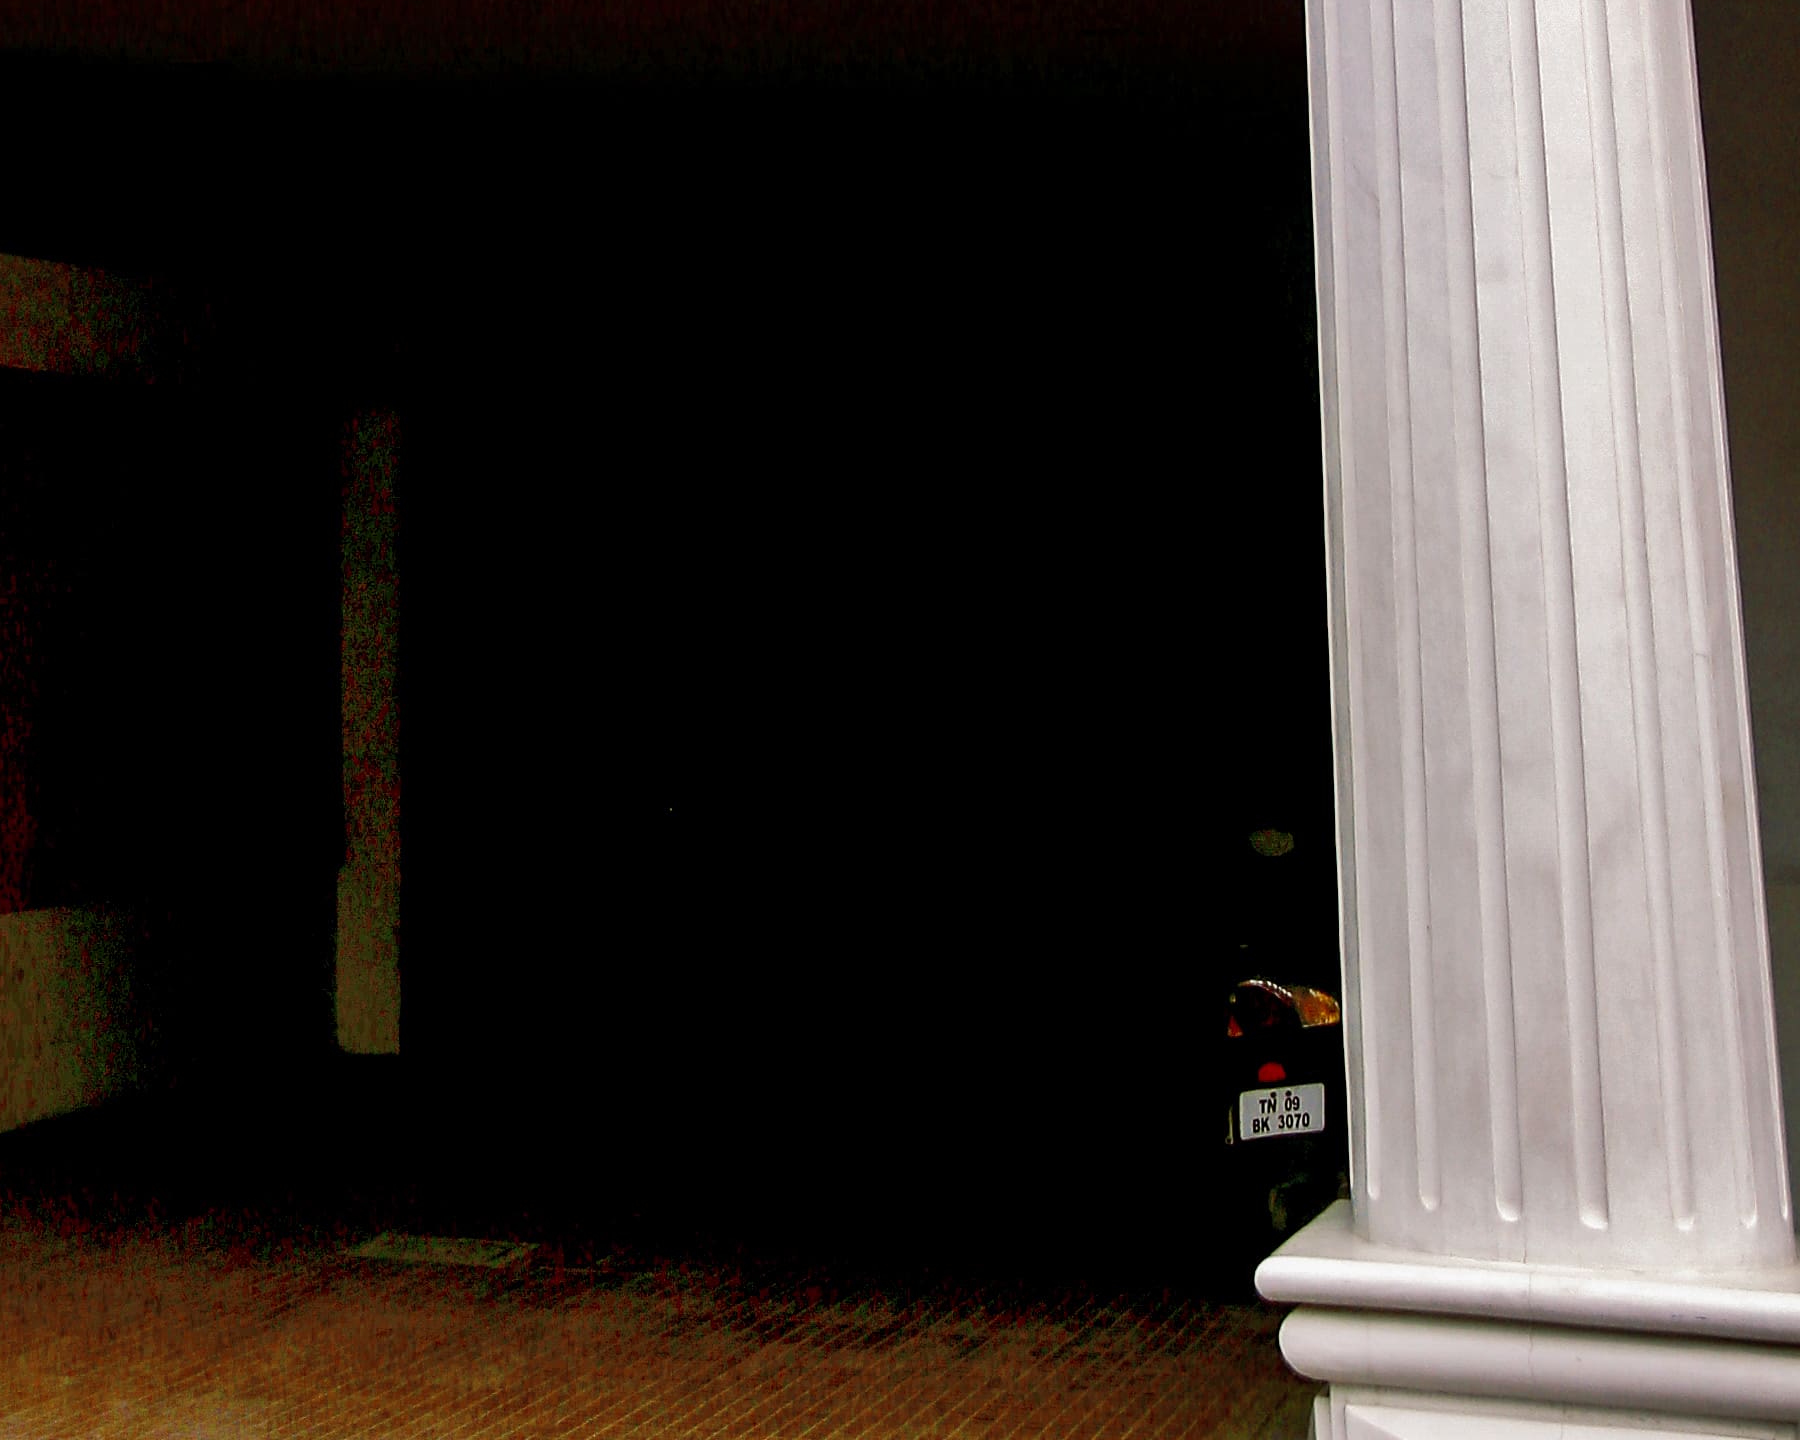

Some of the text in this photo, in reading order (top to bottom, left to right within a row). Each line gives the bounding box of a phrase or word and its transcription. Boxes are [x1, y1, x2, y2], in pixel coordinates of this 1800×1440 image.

[1259, 1095, 1300, 1114] TN 09
[1252, 1112, 1310, 1133] BK 3070
